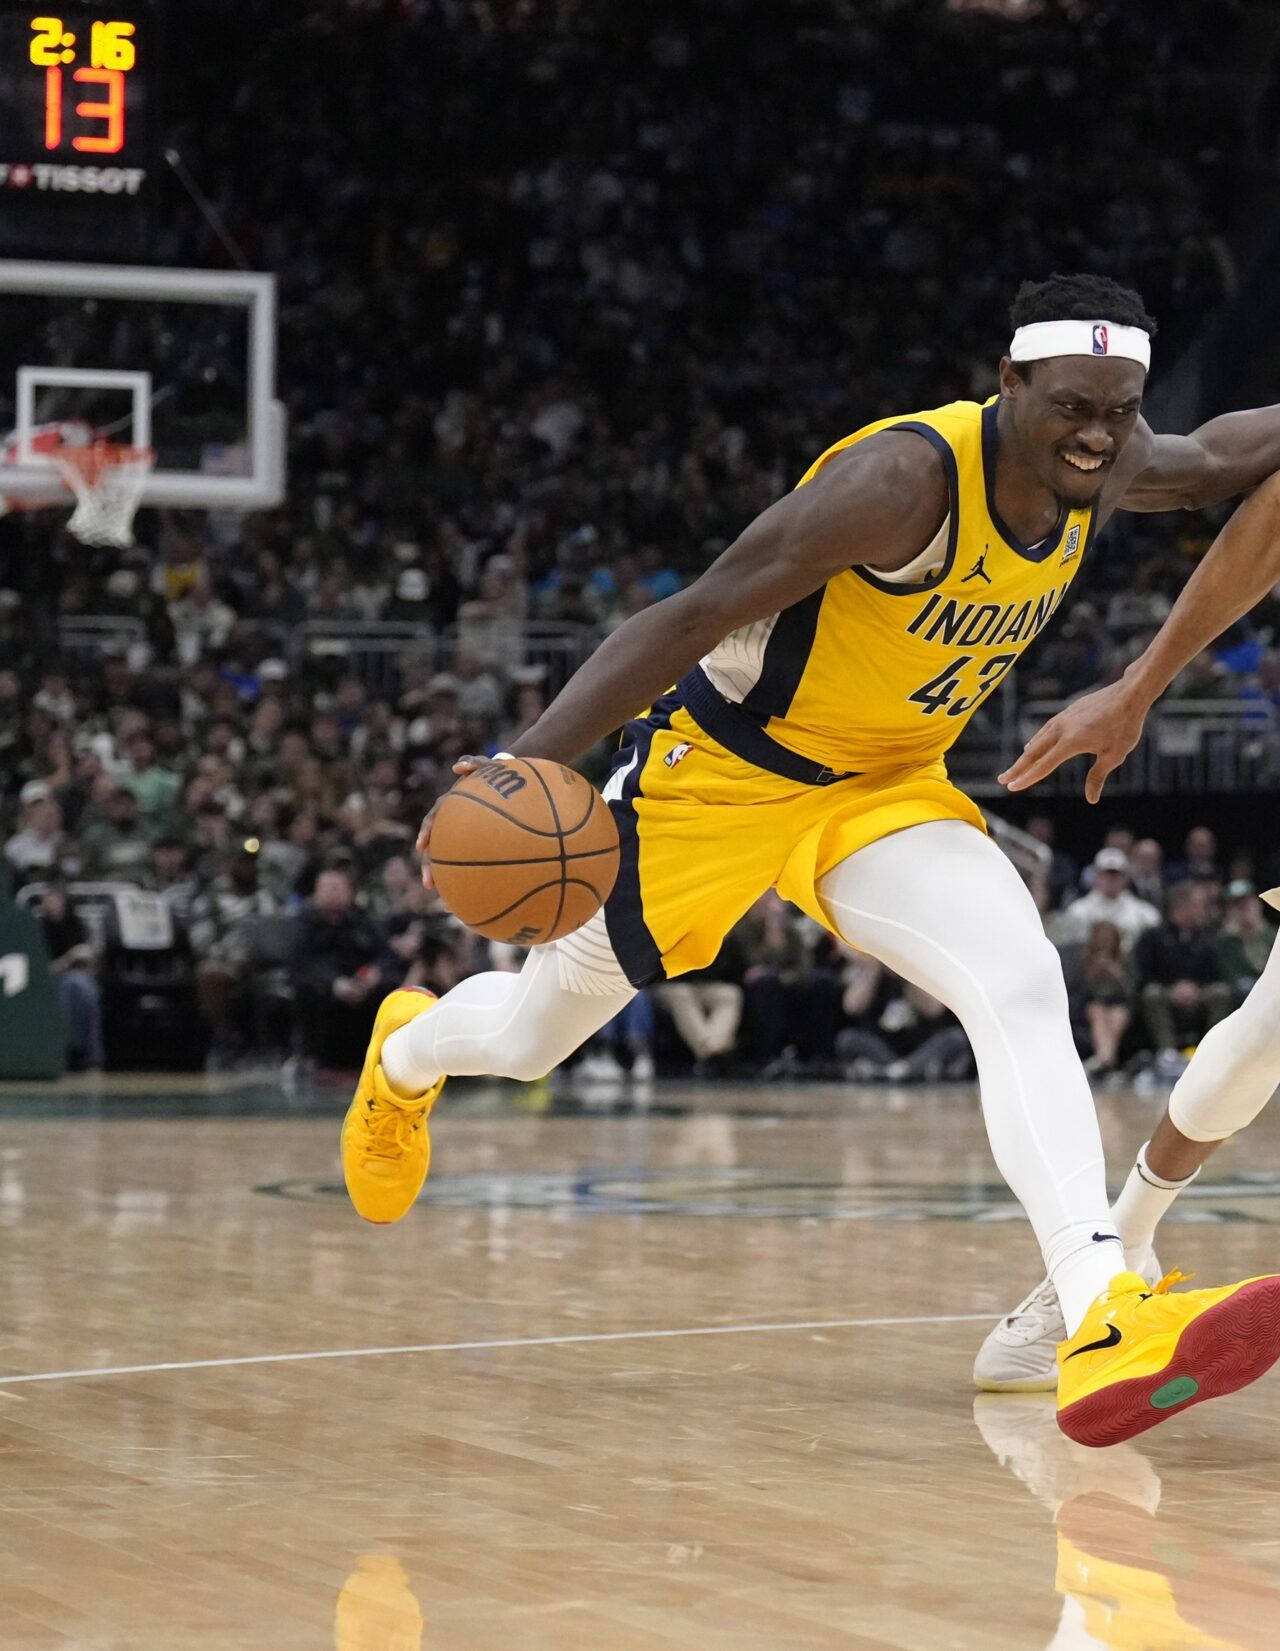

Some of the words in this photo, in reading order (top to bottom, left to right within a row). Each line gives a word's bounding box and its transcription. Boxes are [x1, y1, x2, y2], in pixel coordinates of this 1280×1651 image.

[30, 17, 136, 71] 2:16
[45, 66, 126, 153] 13
[33, 163, 147, 196] TISSOT
[906, 652, 1018, 717] 43
